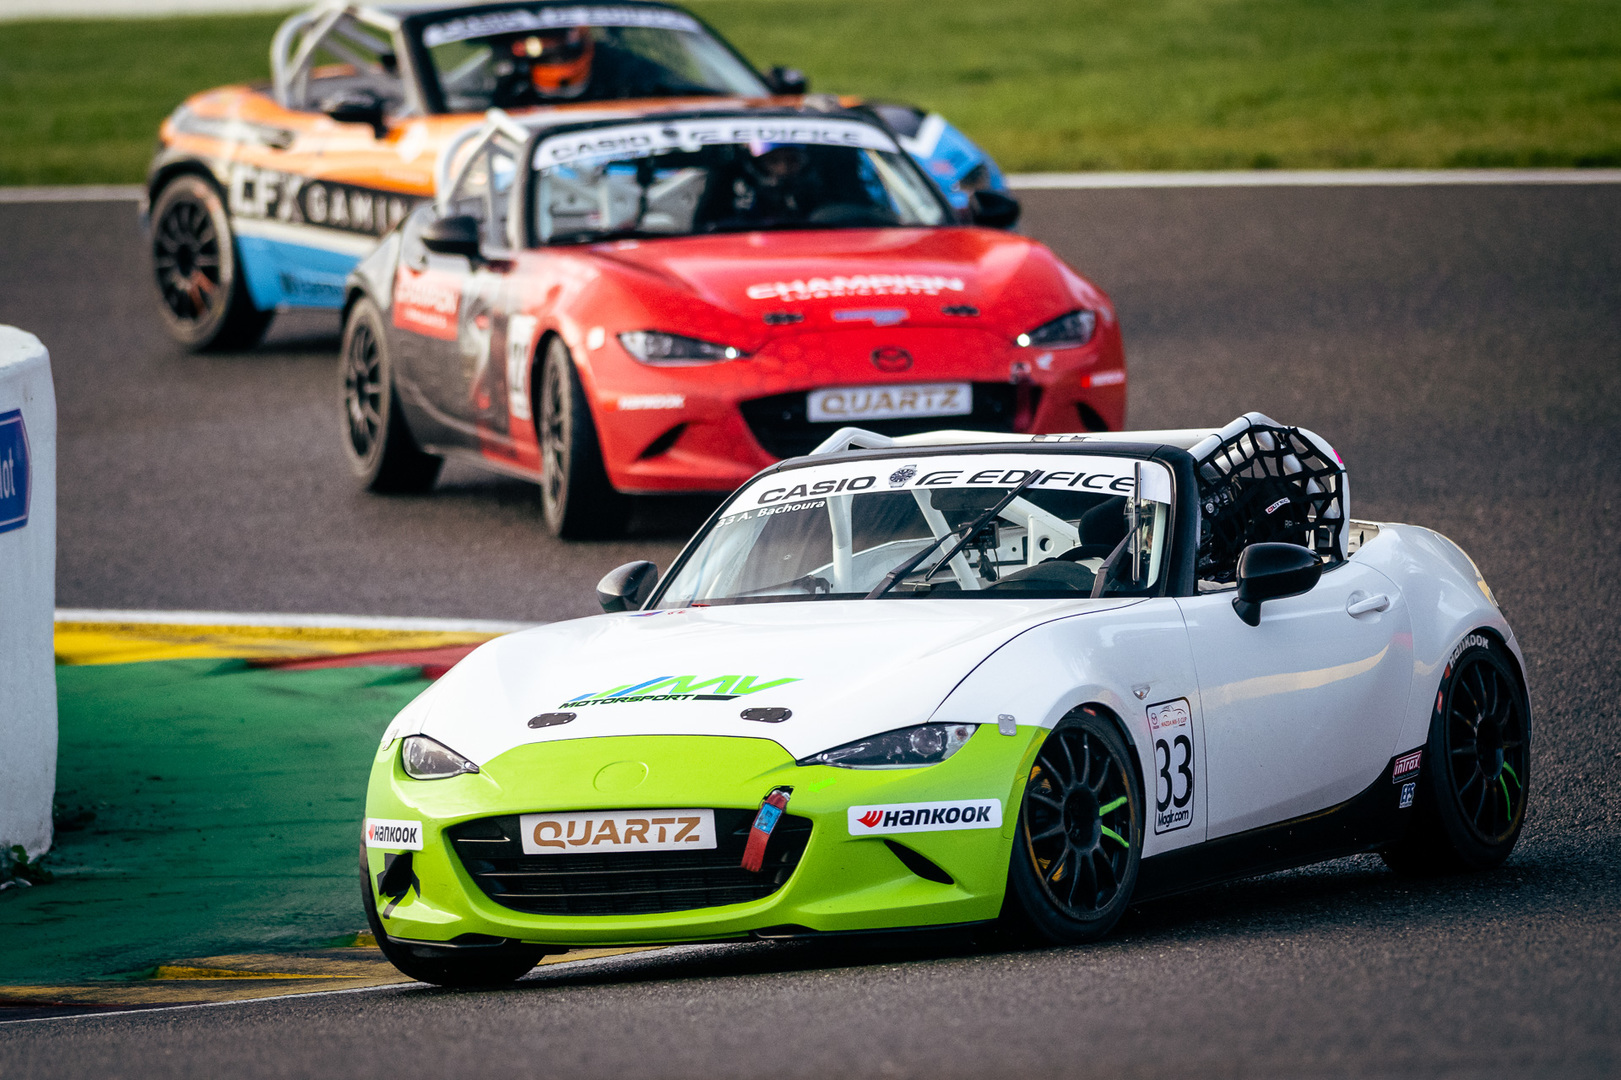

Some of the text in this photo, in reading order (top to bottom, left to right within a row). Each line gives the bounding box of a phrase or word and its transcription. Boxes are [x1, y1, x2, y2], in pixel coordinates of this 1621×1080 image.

[820, 386, 961, 415] QUARTZ
[757, 476, 877, 504] CASIO
[757, 500, 826, 518] Bachoura
[558, 694, 696, 710] MOTORSPORT
[1156, 734, 1192, 812] 33
[532, 816, 702, 850] QUARTZ
